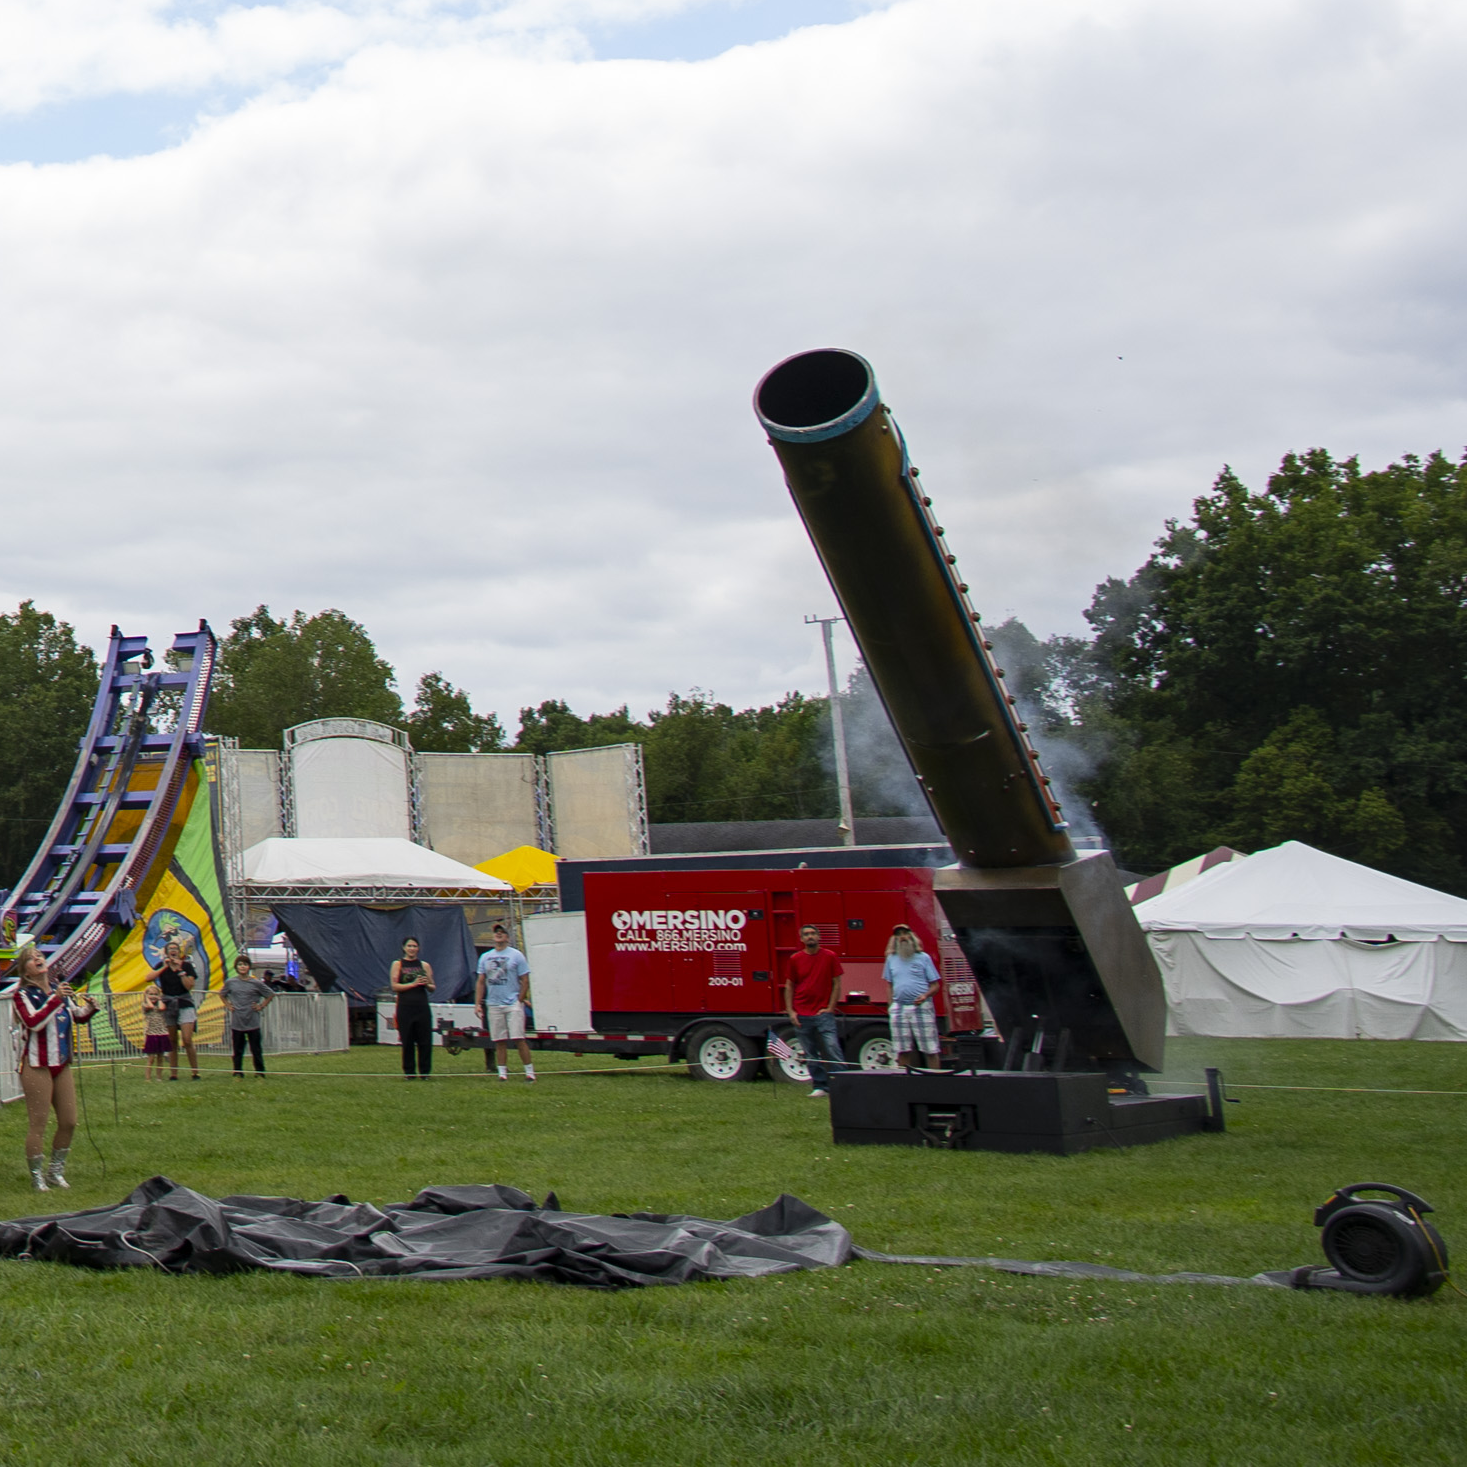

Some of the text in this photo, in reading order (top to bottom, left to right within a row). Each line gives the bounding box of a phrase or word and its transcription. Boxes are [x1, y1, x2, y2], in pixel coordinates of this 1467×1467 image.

[630, 909, 747, 930] MERSINO
[616, 929, 742, 942] CALL 866.MERSINO
[614, 940, 747, 952] www.MERSINO.com
[708, 977, 744, 987] 200-01
